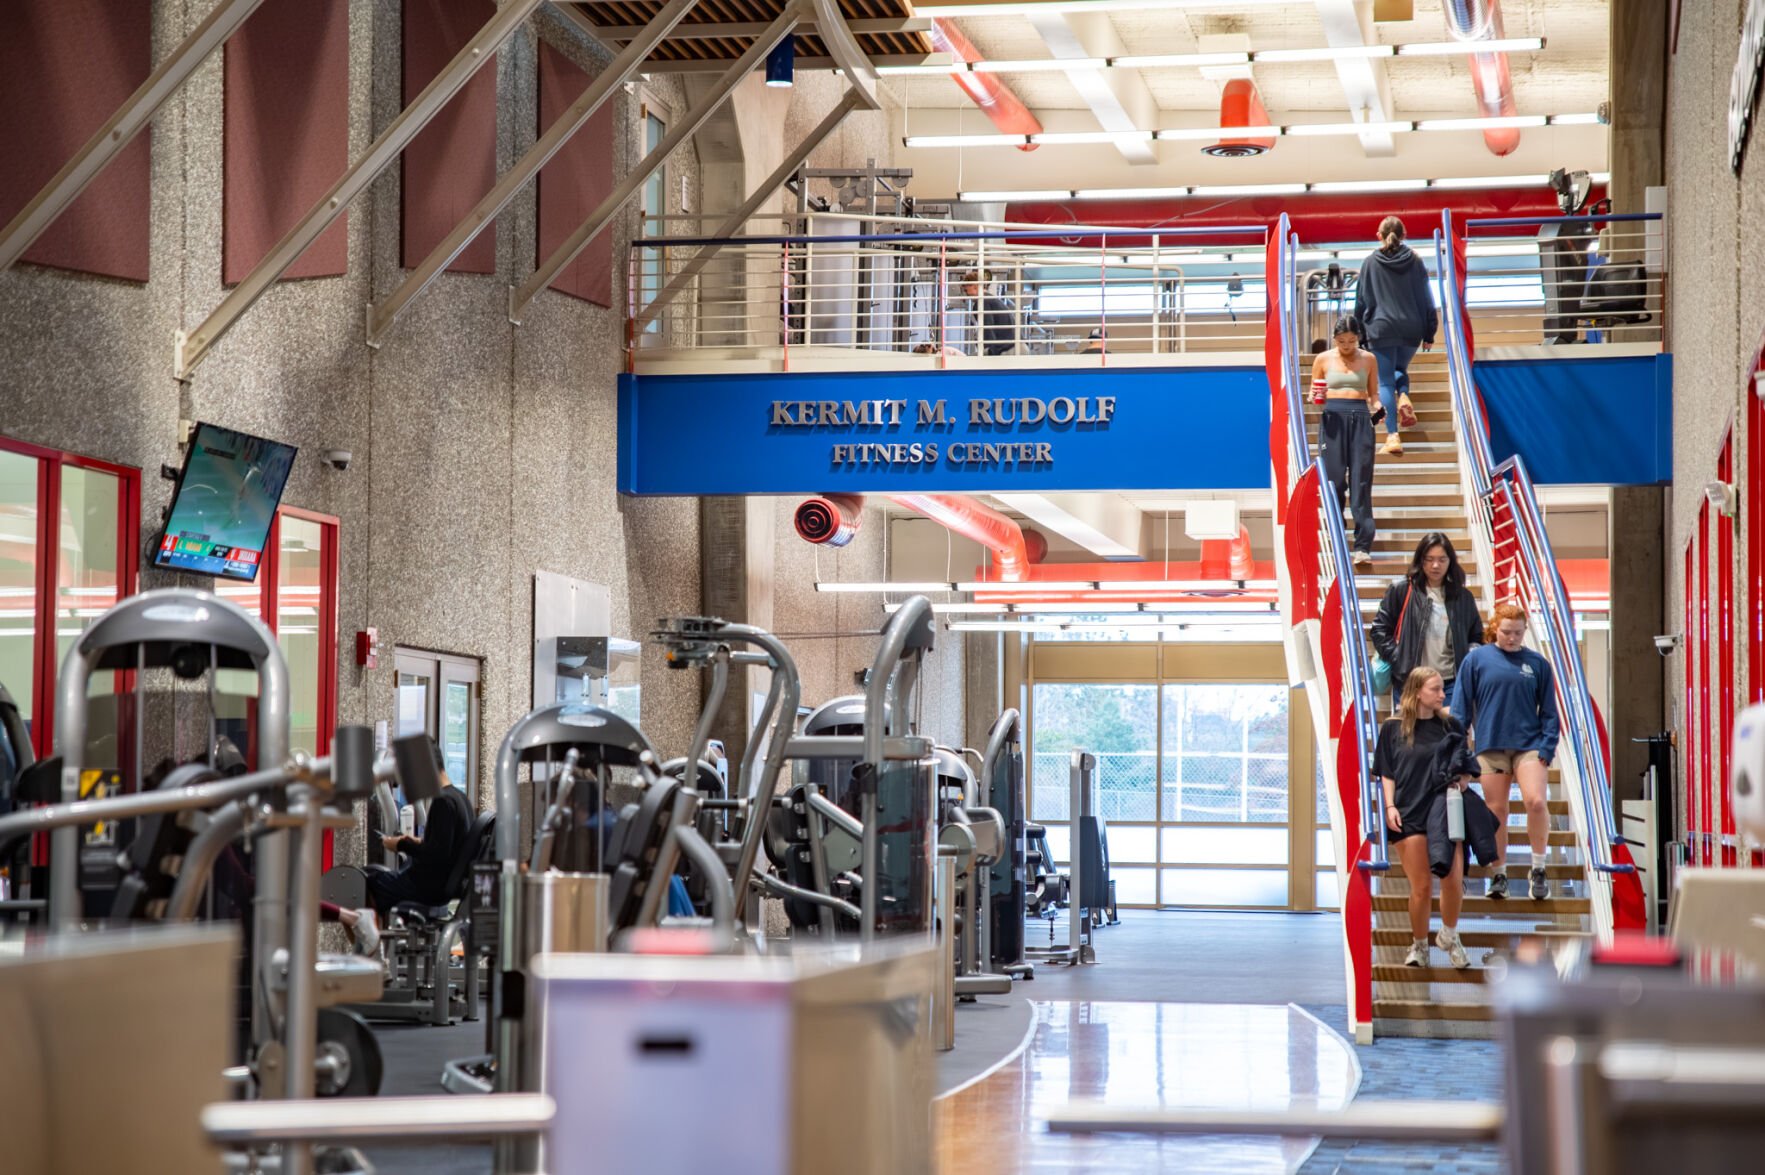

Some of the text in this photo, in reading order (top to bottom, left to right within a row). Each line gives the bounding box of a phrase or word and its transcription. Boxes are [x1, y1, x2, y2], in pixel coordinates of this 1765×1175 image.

[770, 396, 1116, 426] KERMIT M. RUDOLF
[832, 443, 1053, 464] FITNESS CENTER
